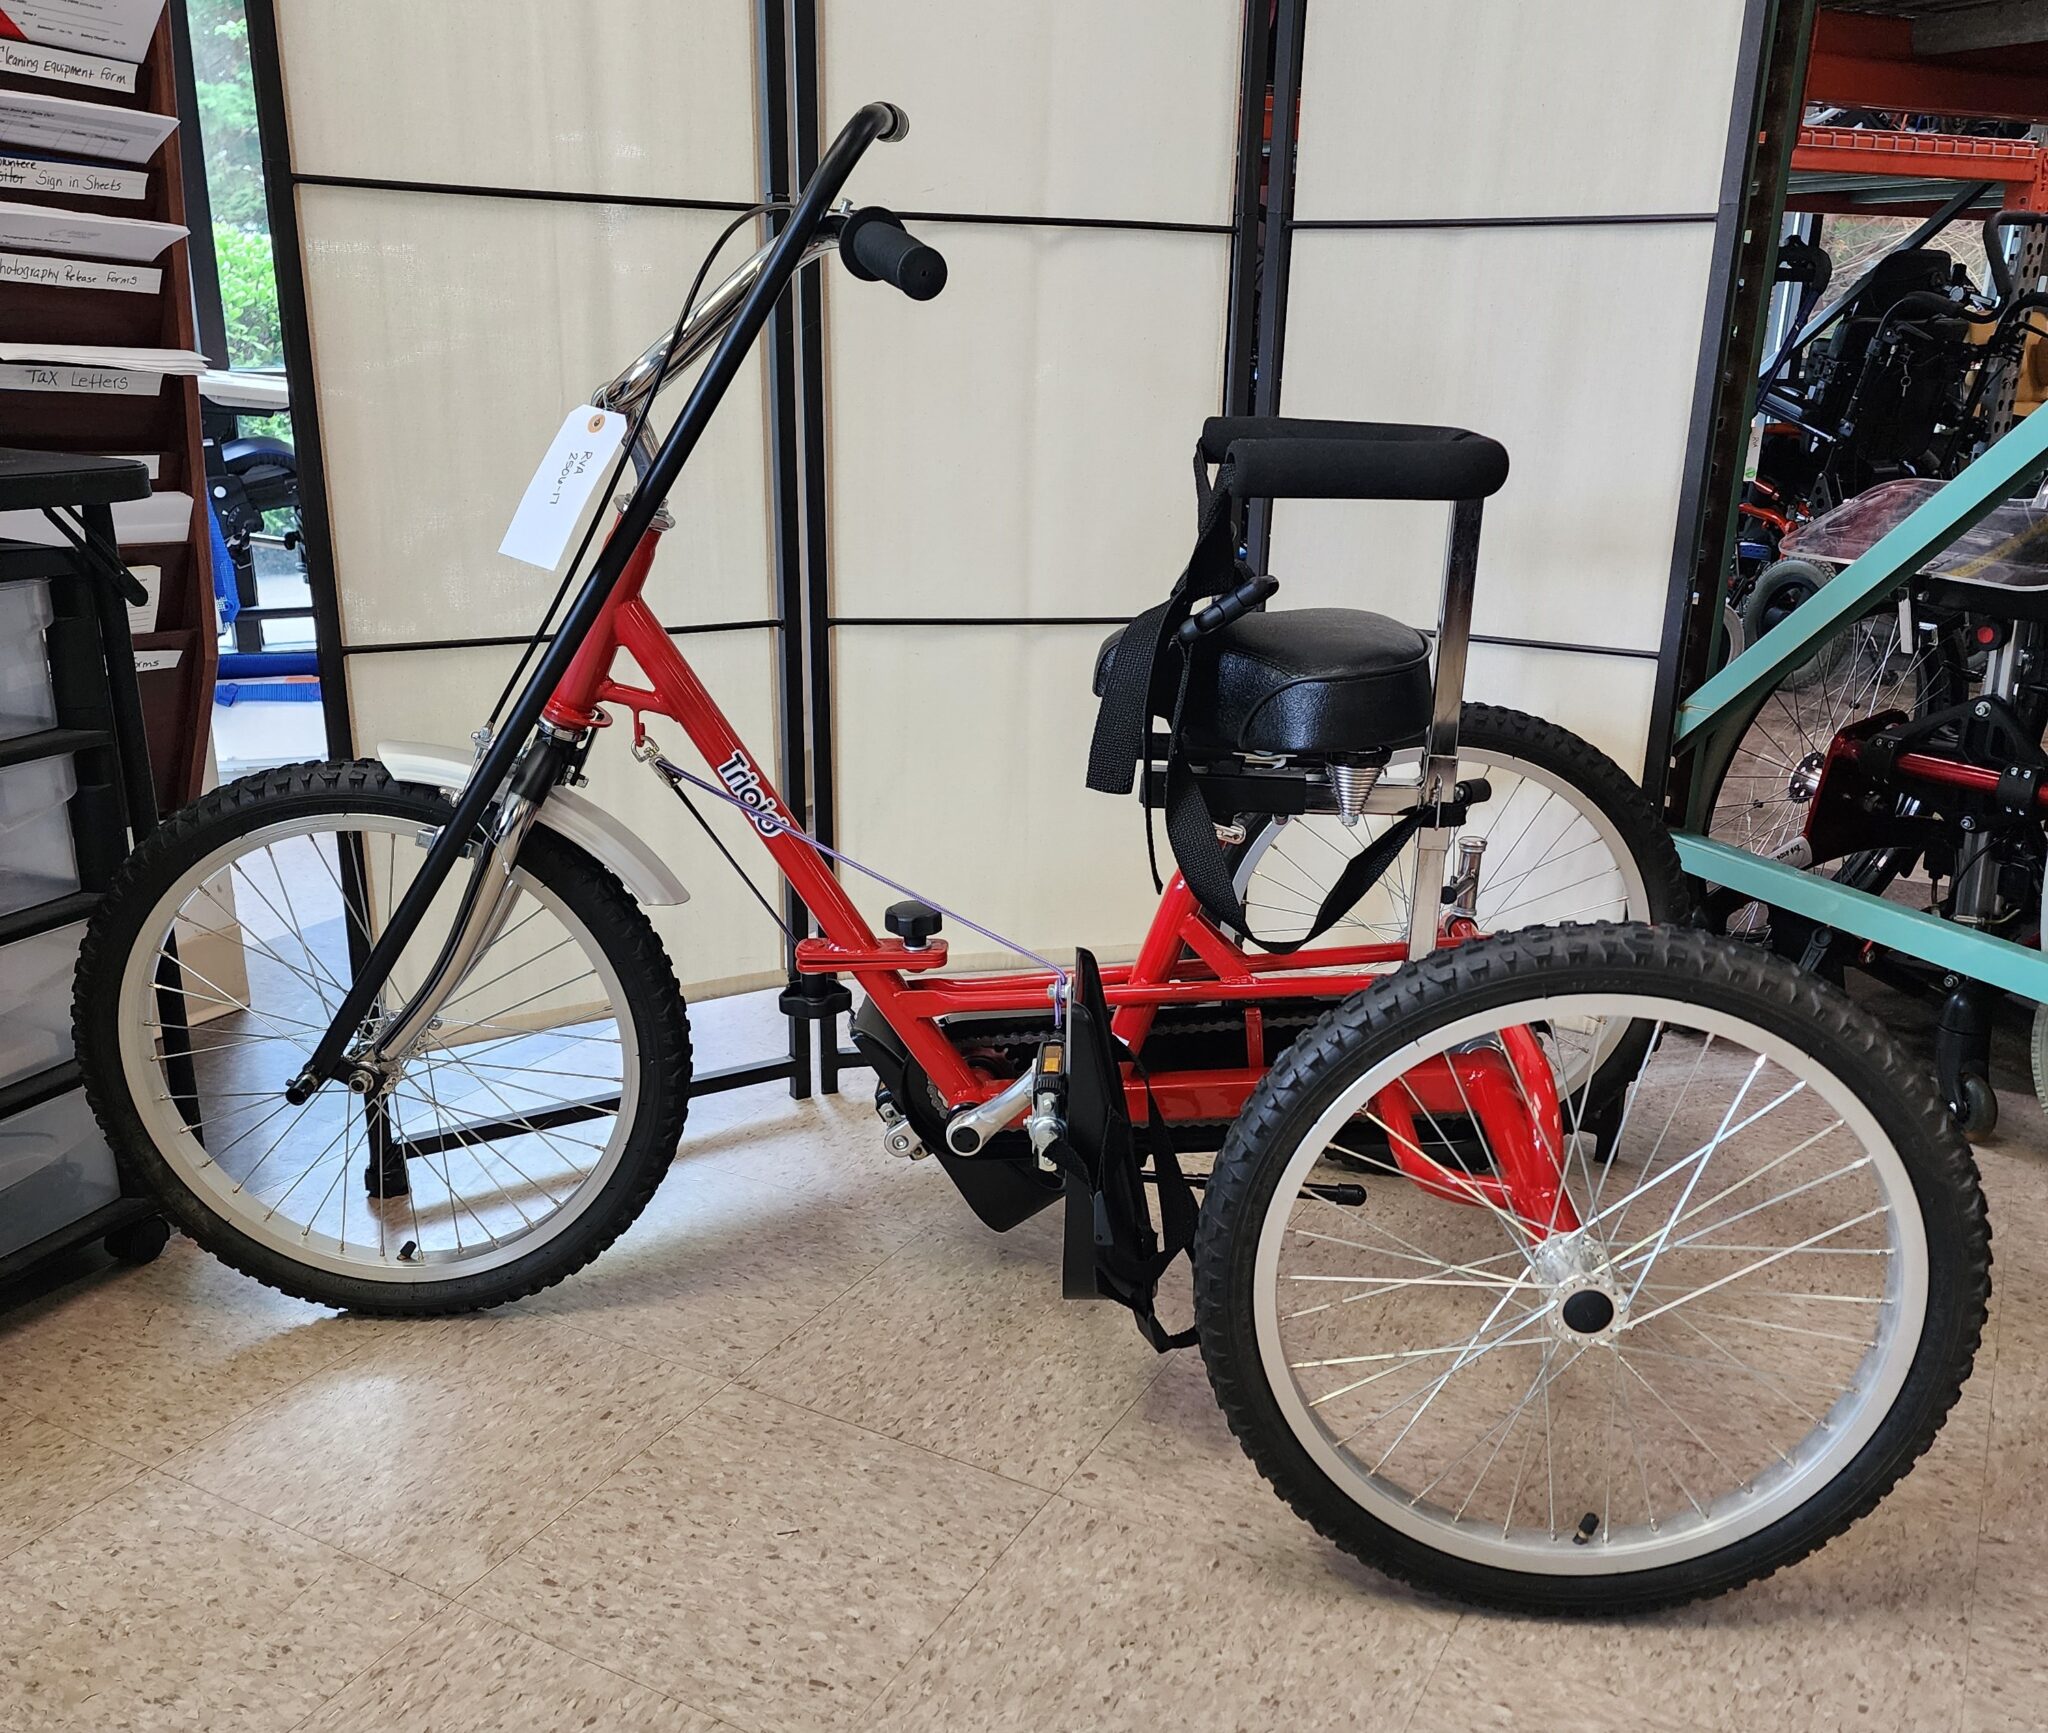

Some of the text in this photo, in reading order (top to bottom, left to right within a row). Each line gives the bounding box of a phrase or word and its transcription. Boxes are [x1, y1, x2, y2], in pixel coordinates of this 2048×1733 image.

[44, 60, 94, 78] Equipment
[100, 67, 126, 84] Form
[36, 169, 62, 190] Sign
[69, 176, 79, 188] in
[83, 174, 122, 191] Sheets
[64, 264, 97, 283] Release
[71, 371, 129, 390] Letters
[574, 451, 593, 475] RVA
[134, 657, 160, 669] orms
